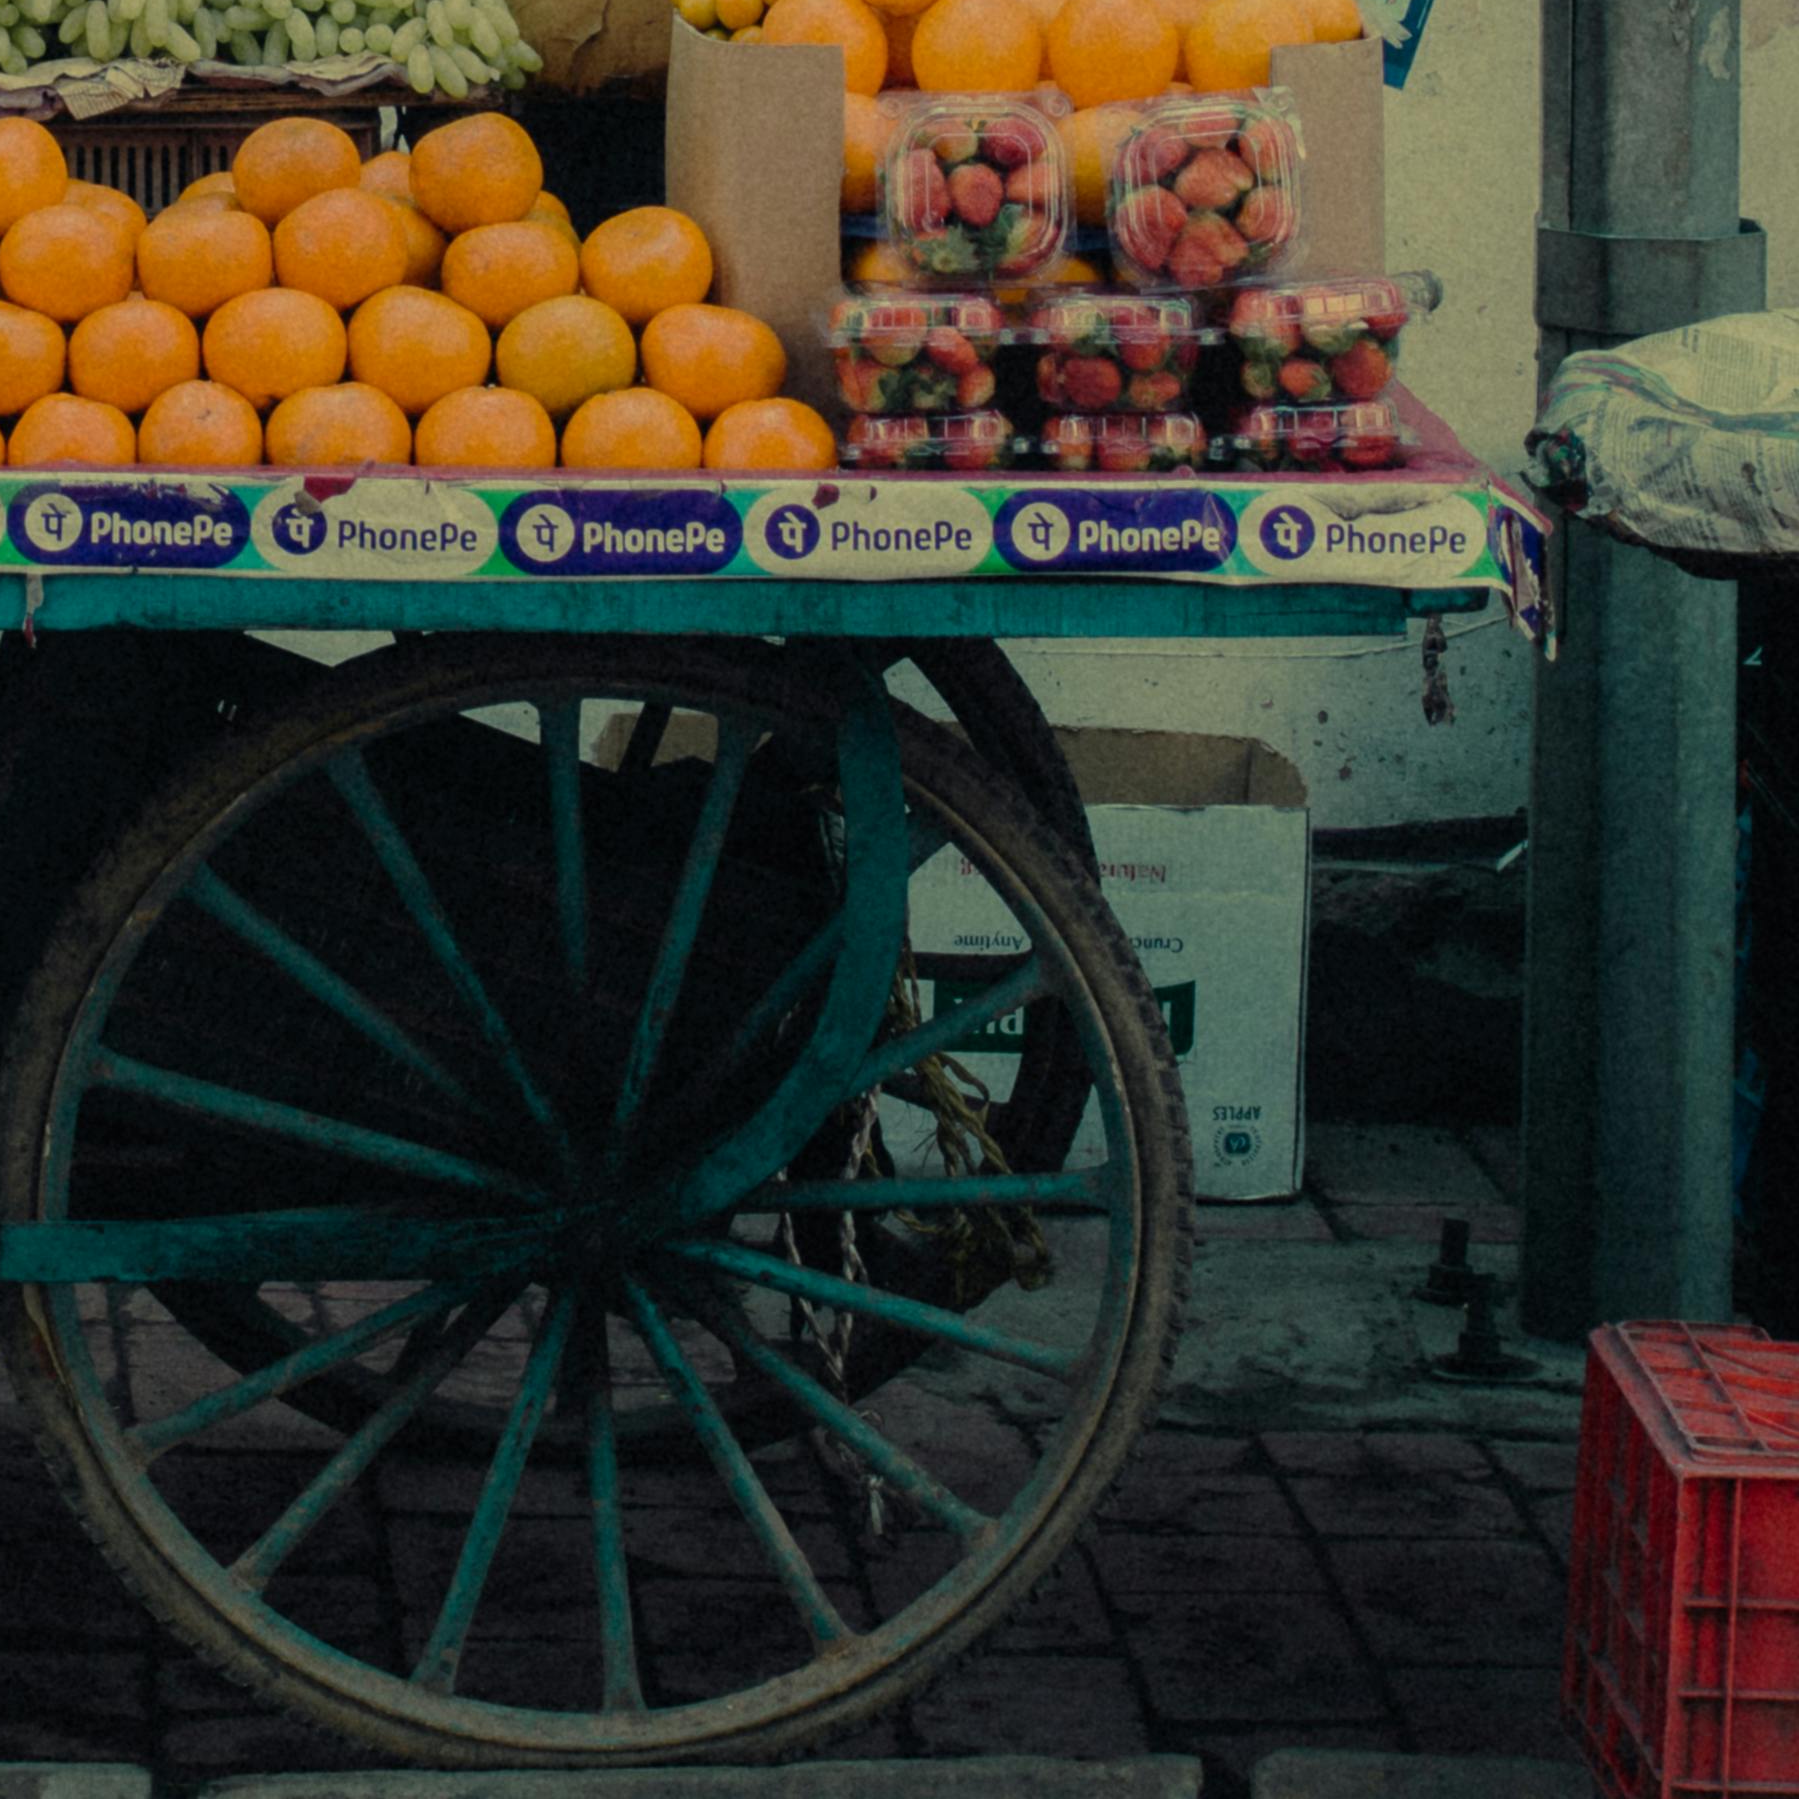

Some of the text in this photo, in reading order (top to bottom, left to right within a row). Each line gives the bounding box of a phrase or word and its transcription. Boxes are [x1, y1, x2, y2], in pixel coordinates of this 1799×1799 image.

[90, 511, 233, 547] PhonePe
[337, 519, 478, 553] PhonePe
[583, 521, 725, 554] PhonePe
[831, 521, 972, 551] PhonePe
[1078, 519, 1221, 554] PhonePe
[1326, 523, 1467, 554] PhonePe
[953, 931, 1184, 954] Crunc Anytime
[1212, 1105, 1262, 1121] APPLES
